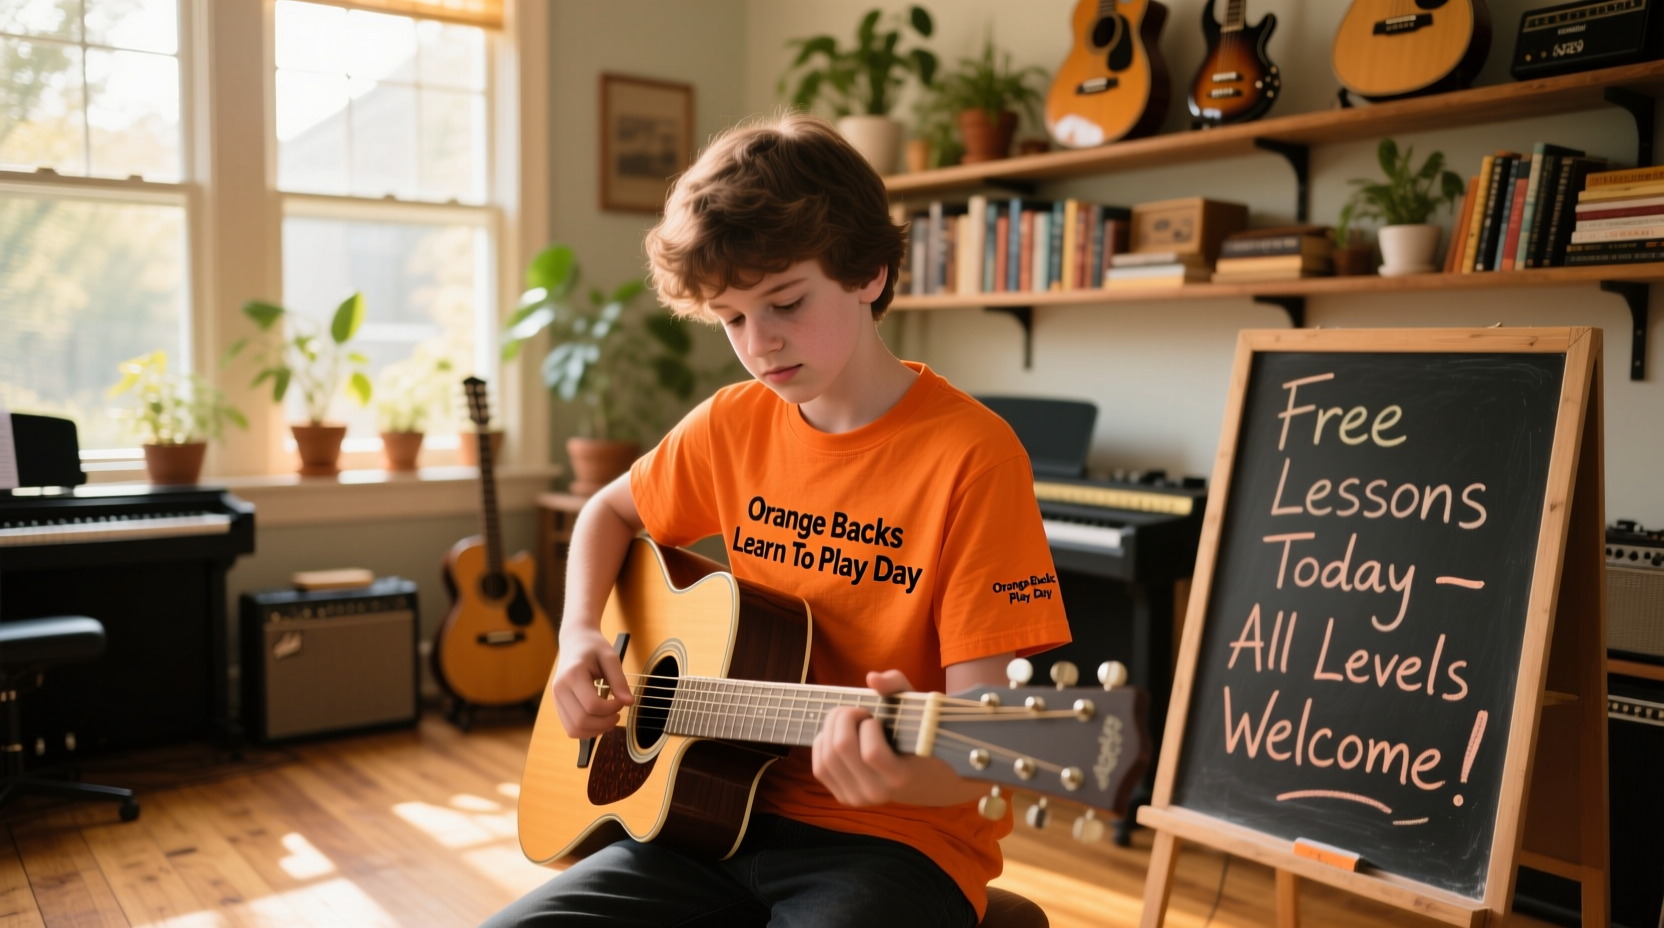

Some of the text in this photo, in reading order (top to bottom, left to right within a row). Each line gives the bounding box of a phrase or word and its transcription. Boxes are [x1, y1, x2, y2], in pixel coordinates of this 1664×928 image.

[1278, 373, 1407, 450] Free
[748, 496, 904, 548] Orange Backs
[1271, 458, 1487, 530] Lessons
[732, 526, 923, 594] Learn To Play Day
[1263, 533, 1415, 632] Today
[1228, 604, 1469, 702] All Levels
